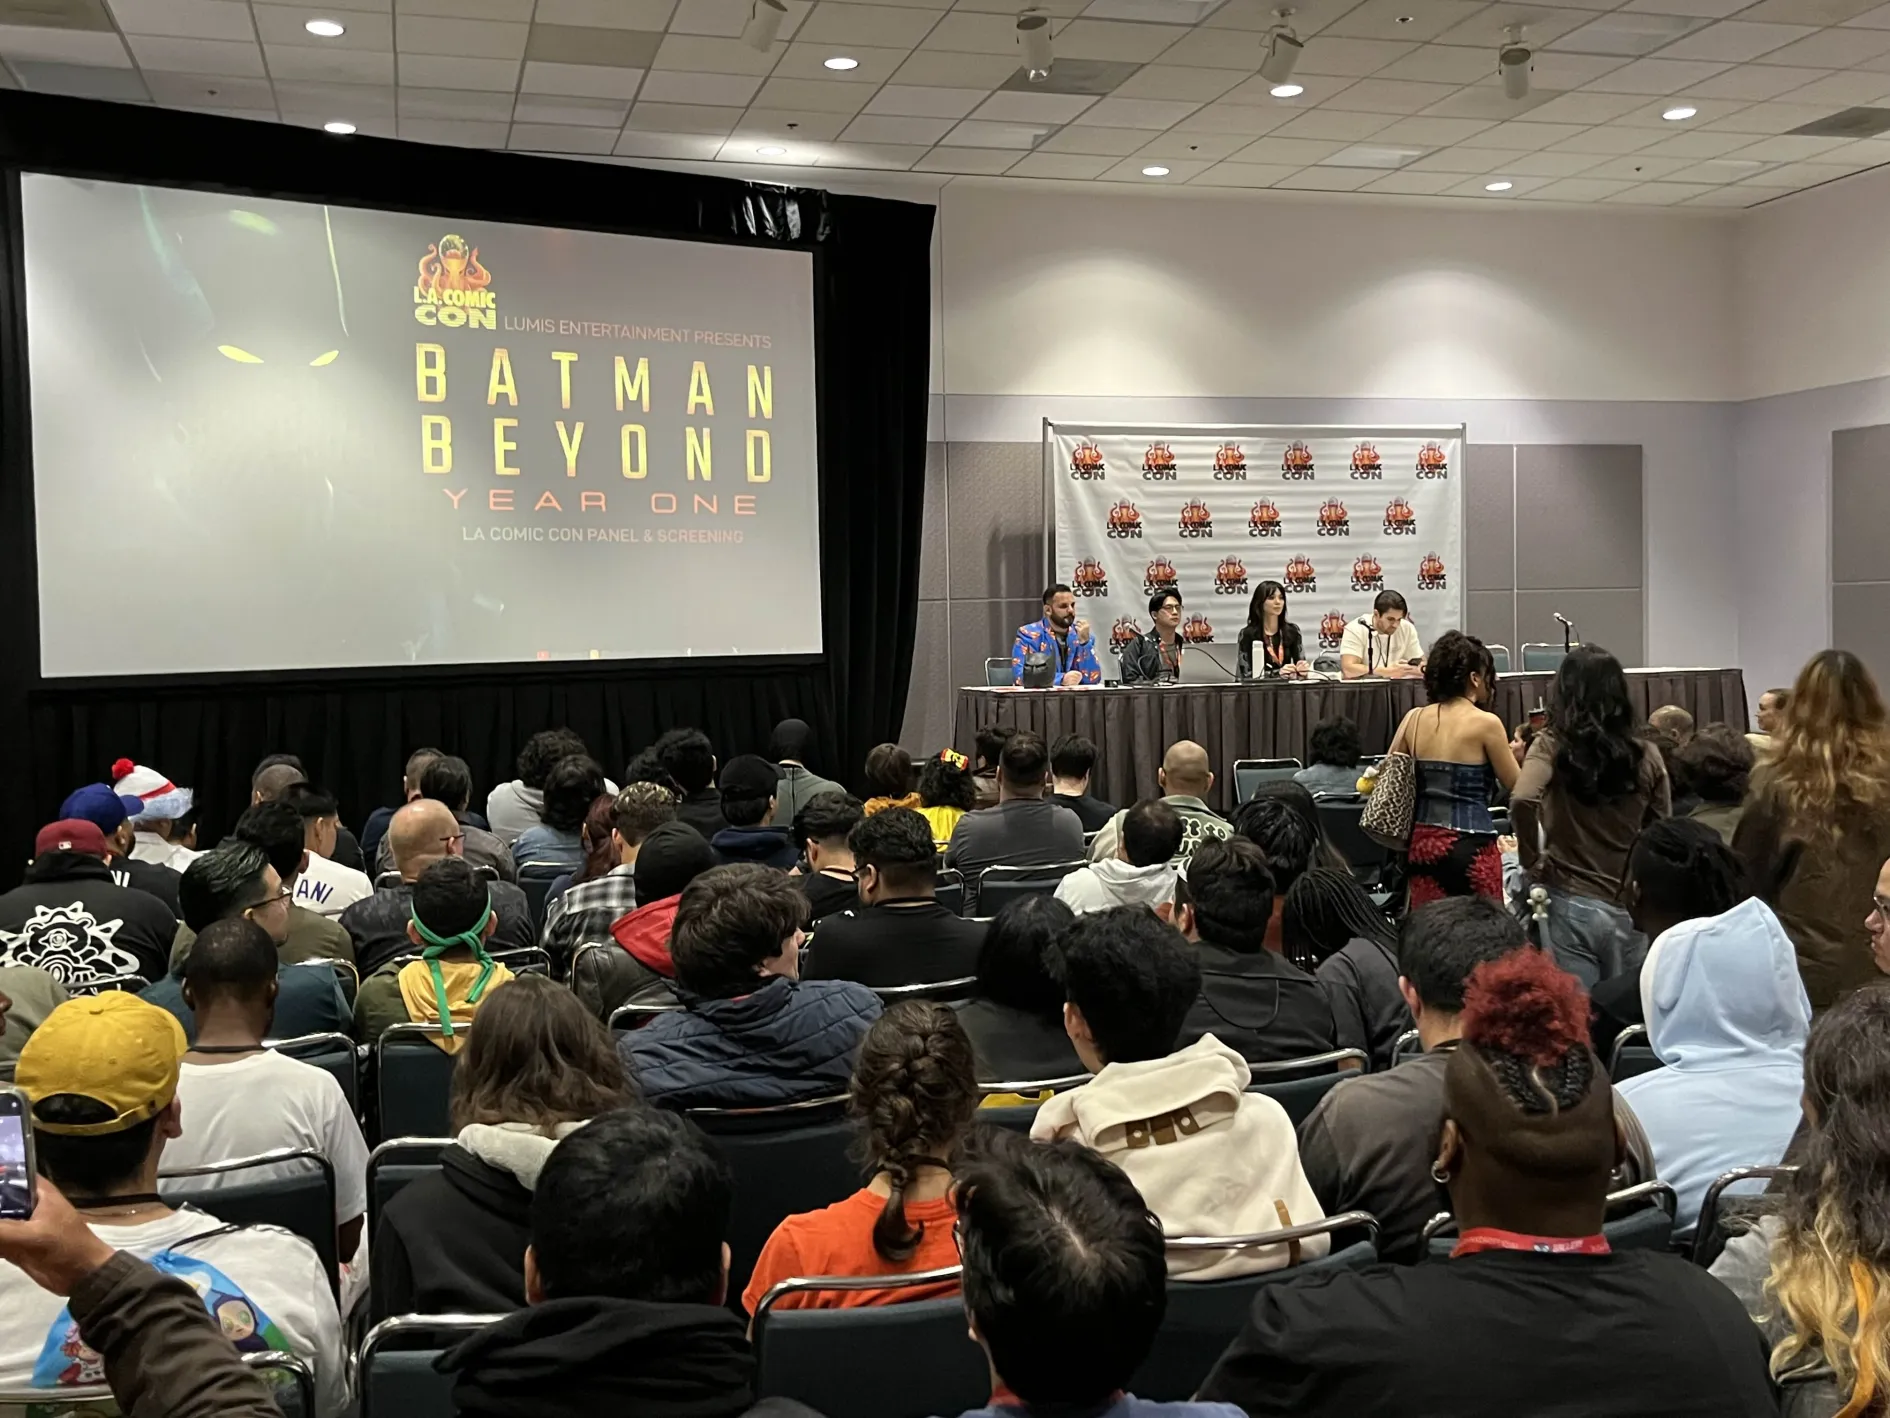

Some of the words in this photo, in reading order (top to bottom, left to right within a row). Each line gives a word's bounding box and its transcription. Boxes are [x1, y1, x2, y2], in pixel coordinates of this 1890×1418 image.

[442, 288, 496, 309] COMIC
[414, 304, 497, 330] CON
[504, 316, 555, 333] LUMIS
[559, 319, 691, 343] ENTERTAINMENT
[694, 330, 772, 349] PRESENTS
[415, 342, 773, 419] BATMAN
[421, 415, 772, 483] BEYOND
[442, 488, 606, 512] YEAR
[651, 492, 757, 515] ONE
[462, 526, 486, 541] LA
[490, 527, 544, 542] COMIC
[548, 527, 583, 542] CON
[587, 528, 639, 543] PANEL
[643, 528, 653, 543] &
[657, 528, 744, 544] SCREENING
